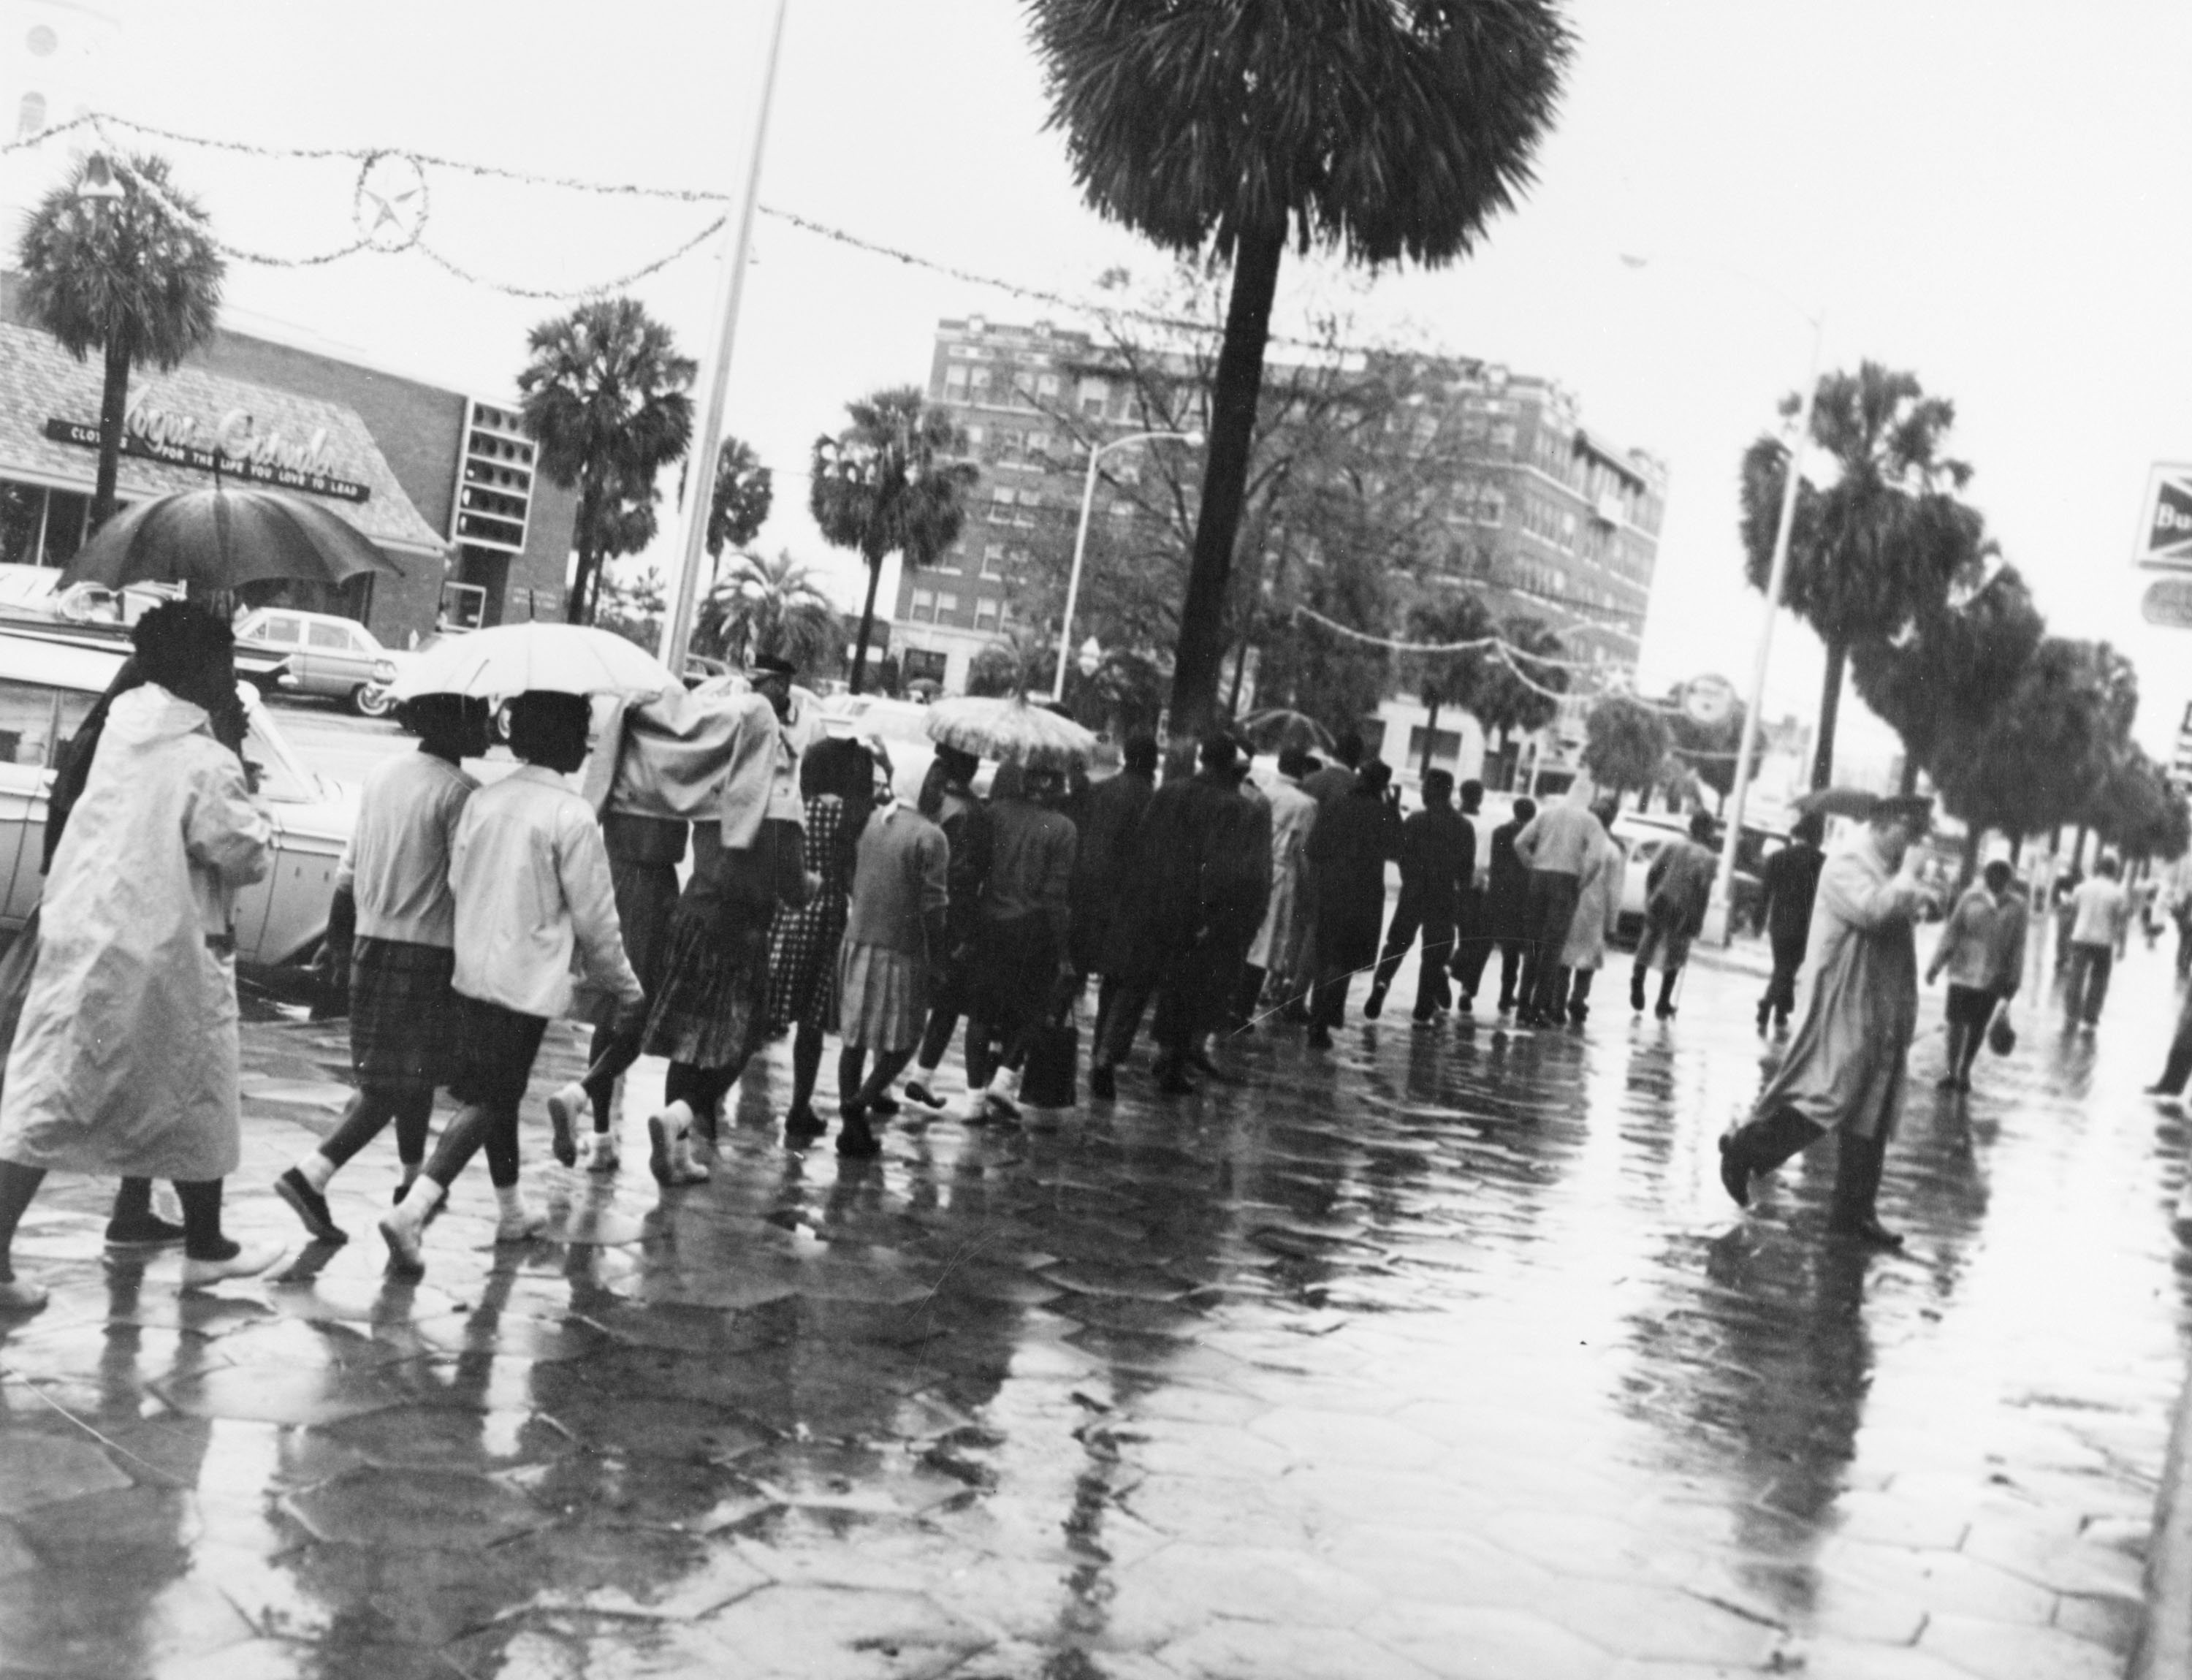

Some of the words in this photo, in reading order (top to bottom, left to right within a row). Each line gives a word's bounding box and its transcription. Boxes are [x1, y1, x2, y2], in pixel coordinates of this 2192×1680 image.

[71, 427, 128, 449] CLOTS
[161, 446, 185, 460] FOR
[193, 452, 214, 467] THE
[220, 458, 244, 474] LIFE
[251, 465, 273, 479] YOU
[278, 471, 305, 487] LOVE
[312, 477, 325, 490] TO
[330, 482, 358, 496] LEAD
